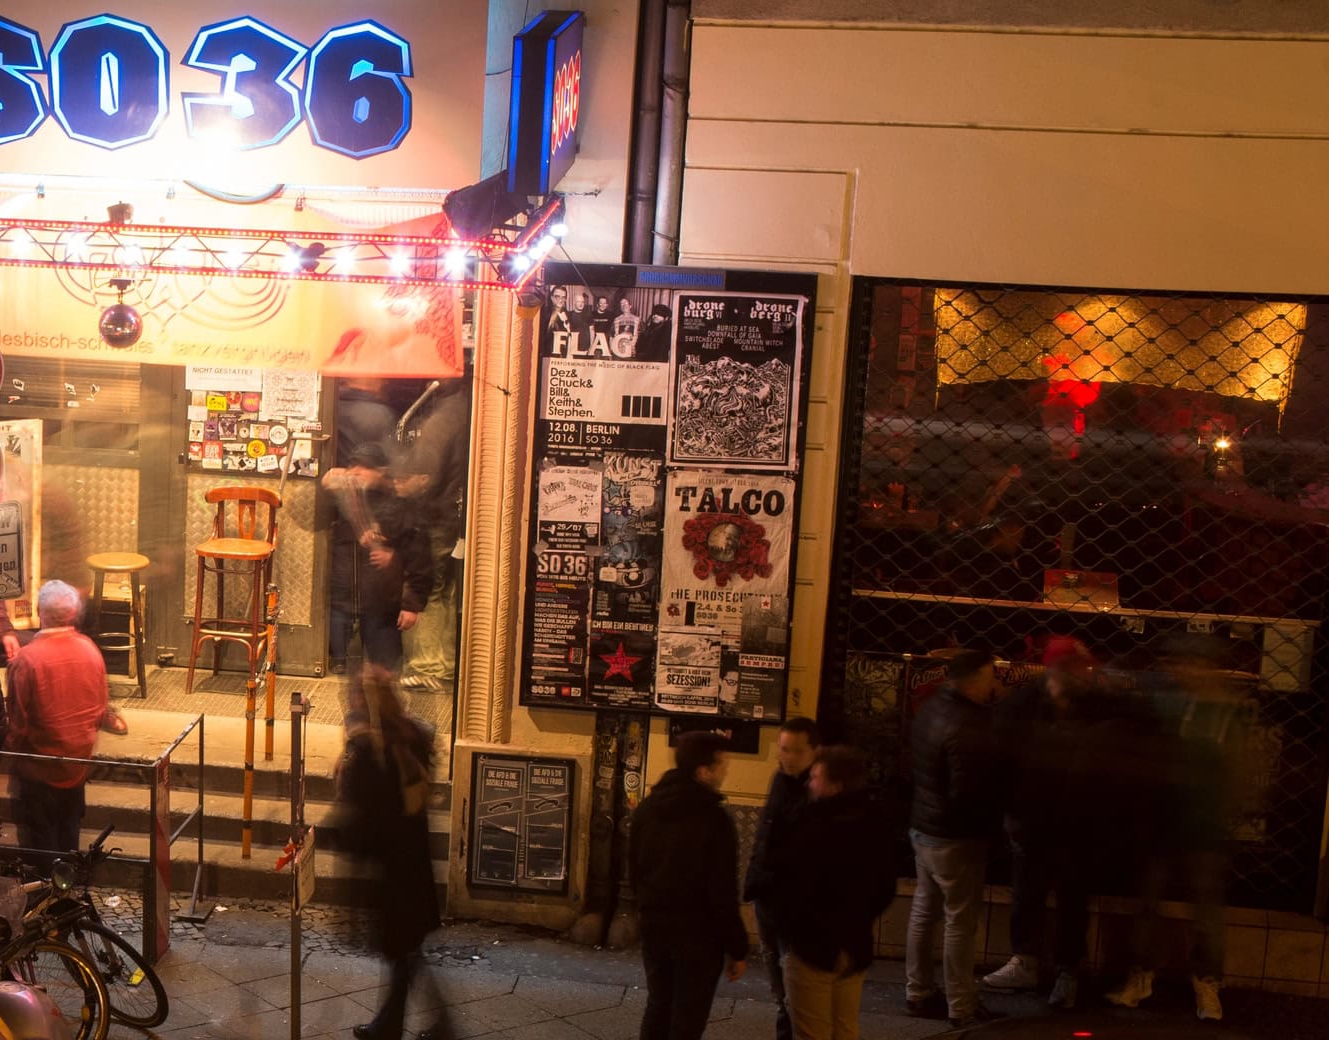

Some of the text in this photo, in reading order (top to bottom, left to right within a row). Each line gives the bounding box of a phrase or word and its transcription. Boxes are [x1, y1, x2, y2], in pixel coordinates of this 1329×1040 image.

[552, 331, 634, 359] FLAG
[550, 360, 586, 368] PERFORMING
[550, 367, 578, 378] Dez&
[550, 377, 594, 388] Chuck&
[549, 387, 570, 397] Bill&
[548, 397, 583, 408] Keith&
[548, 406, 595, 418] Stephen.
[549, 422, 620, 435] 12.08. BERLIN
[548, 433, 574, 443] 2016
[675, 486, 785, 516] TALCO
[716, 604, 723, 612] &
[666, 673, 711, 687] SEZESSION!
[531, 685, 556, 695] SO36
